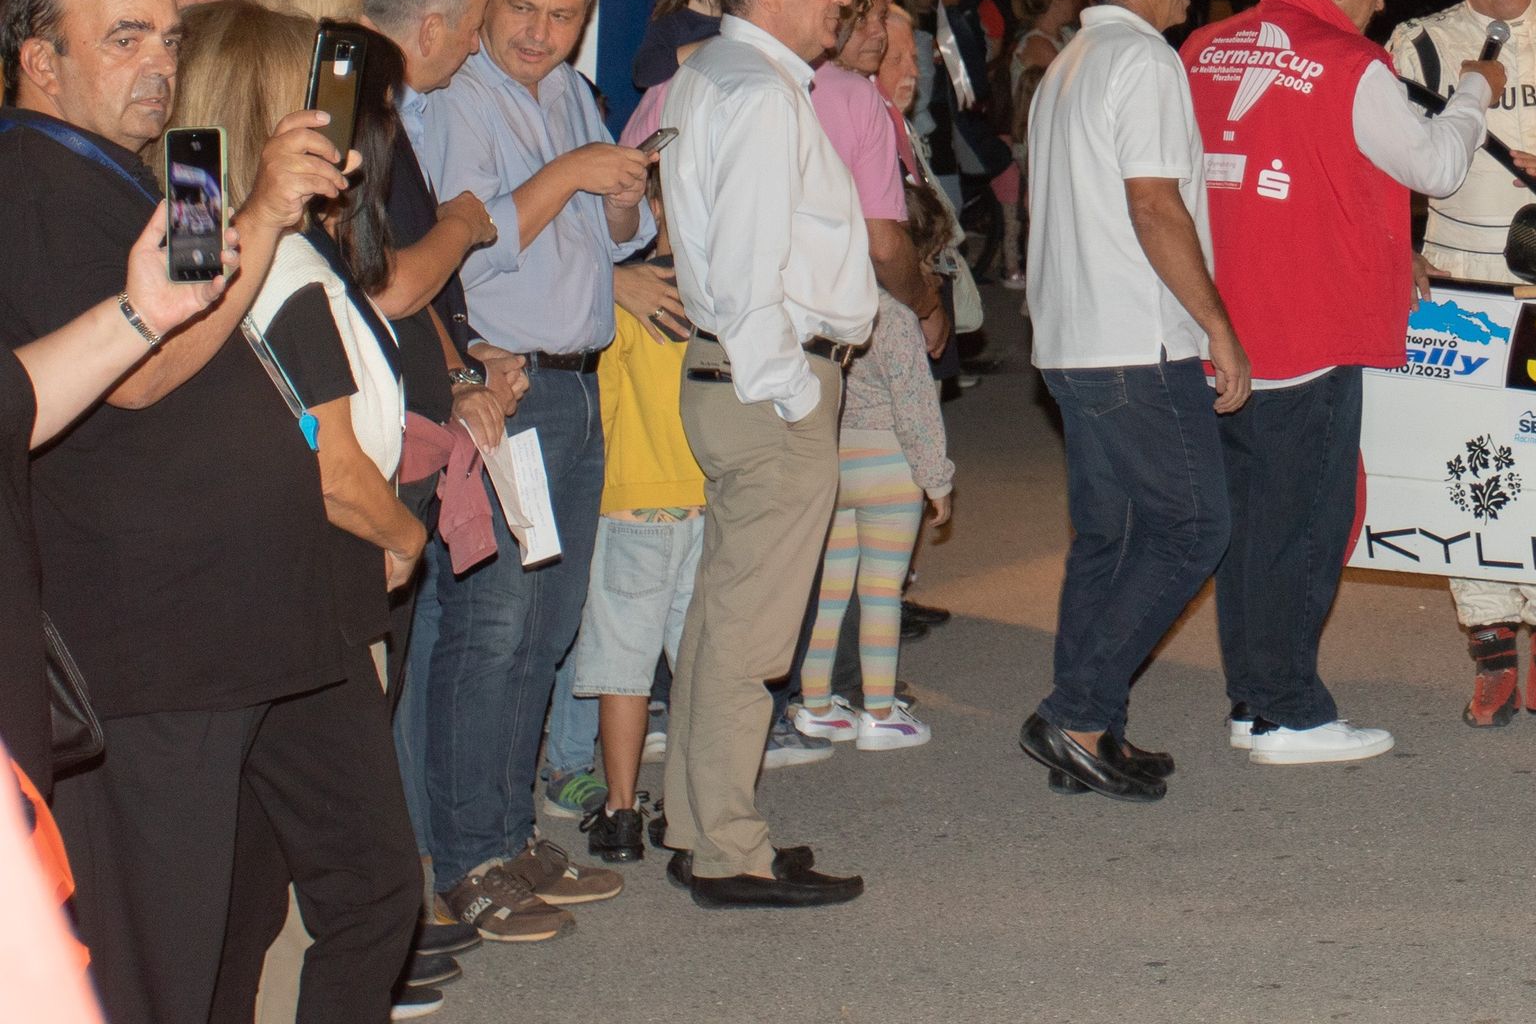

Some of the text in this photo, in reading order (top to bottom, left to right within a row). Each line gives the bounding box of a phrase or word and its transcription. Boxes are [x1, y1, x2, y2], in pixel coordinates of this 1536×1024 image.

[1199, 46, 1324, 80] GermanCup
[1274, 73, 1314, 95] 2008
[1406, 347, 1490, 376] ally
